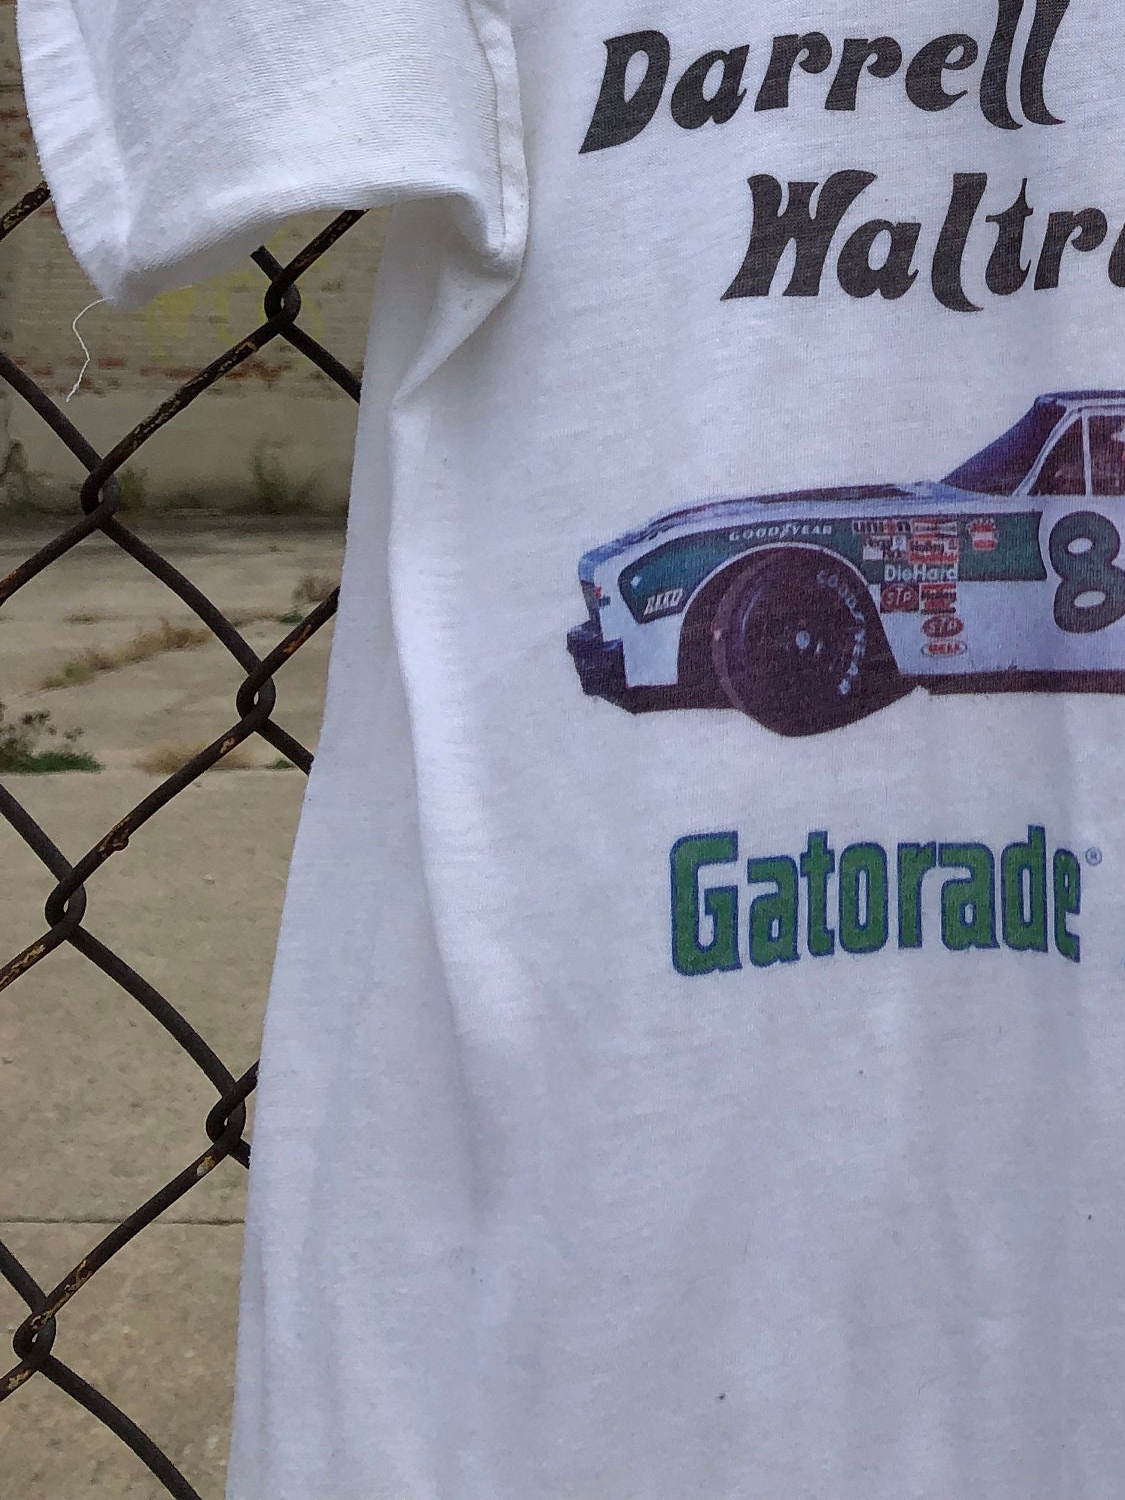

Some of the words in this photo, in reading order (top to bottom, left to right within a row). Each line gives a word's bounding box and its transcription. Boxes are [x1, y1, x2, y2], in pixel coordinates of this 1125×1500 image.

[728, 523, 833, 542] GOODYEAR
[883, 562, 959, 583] DieHard
[670, 824, 1081, 977] Gatorade
